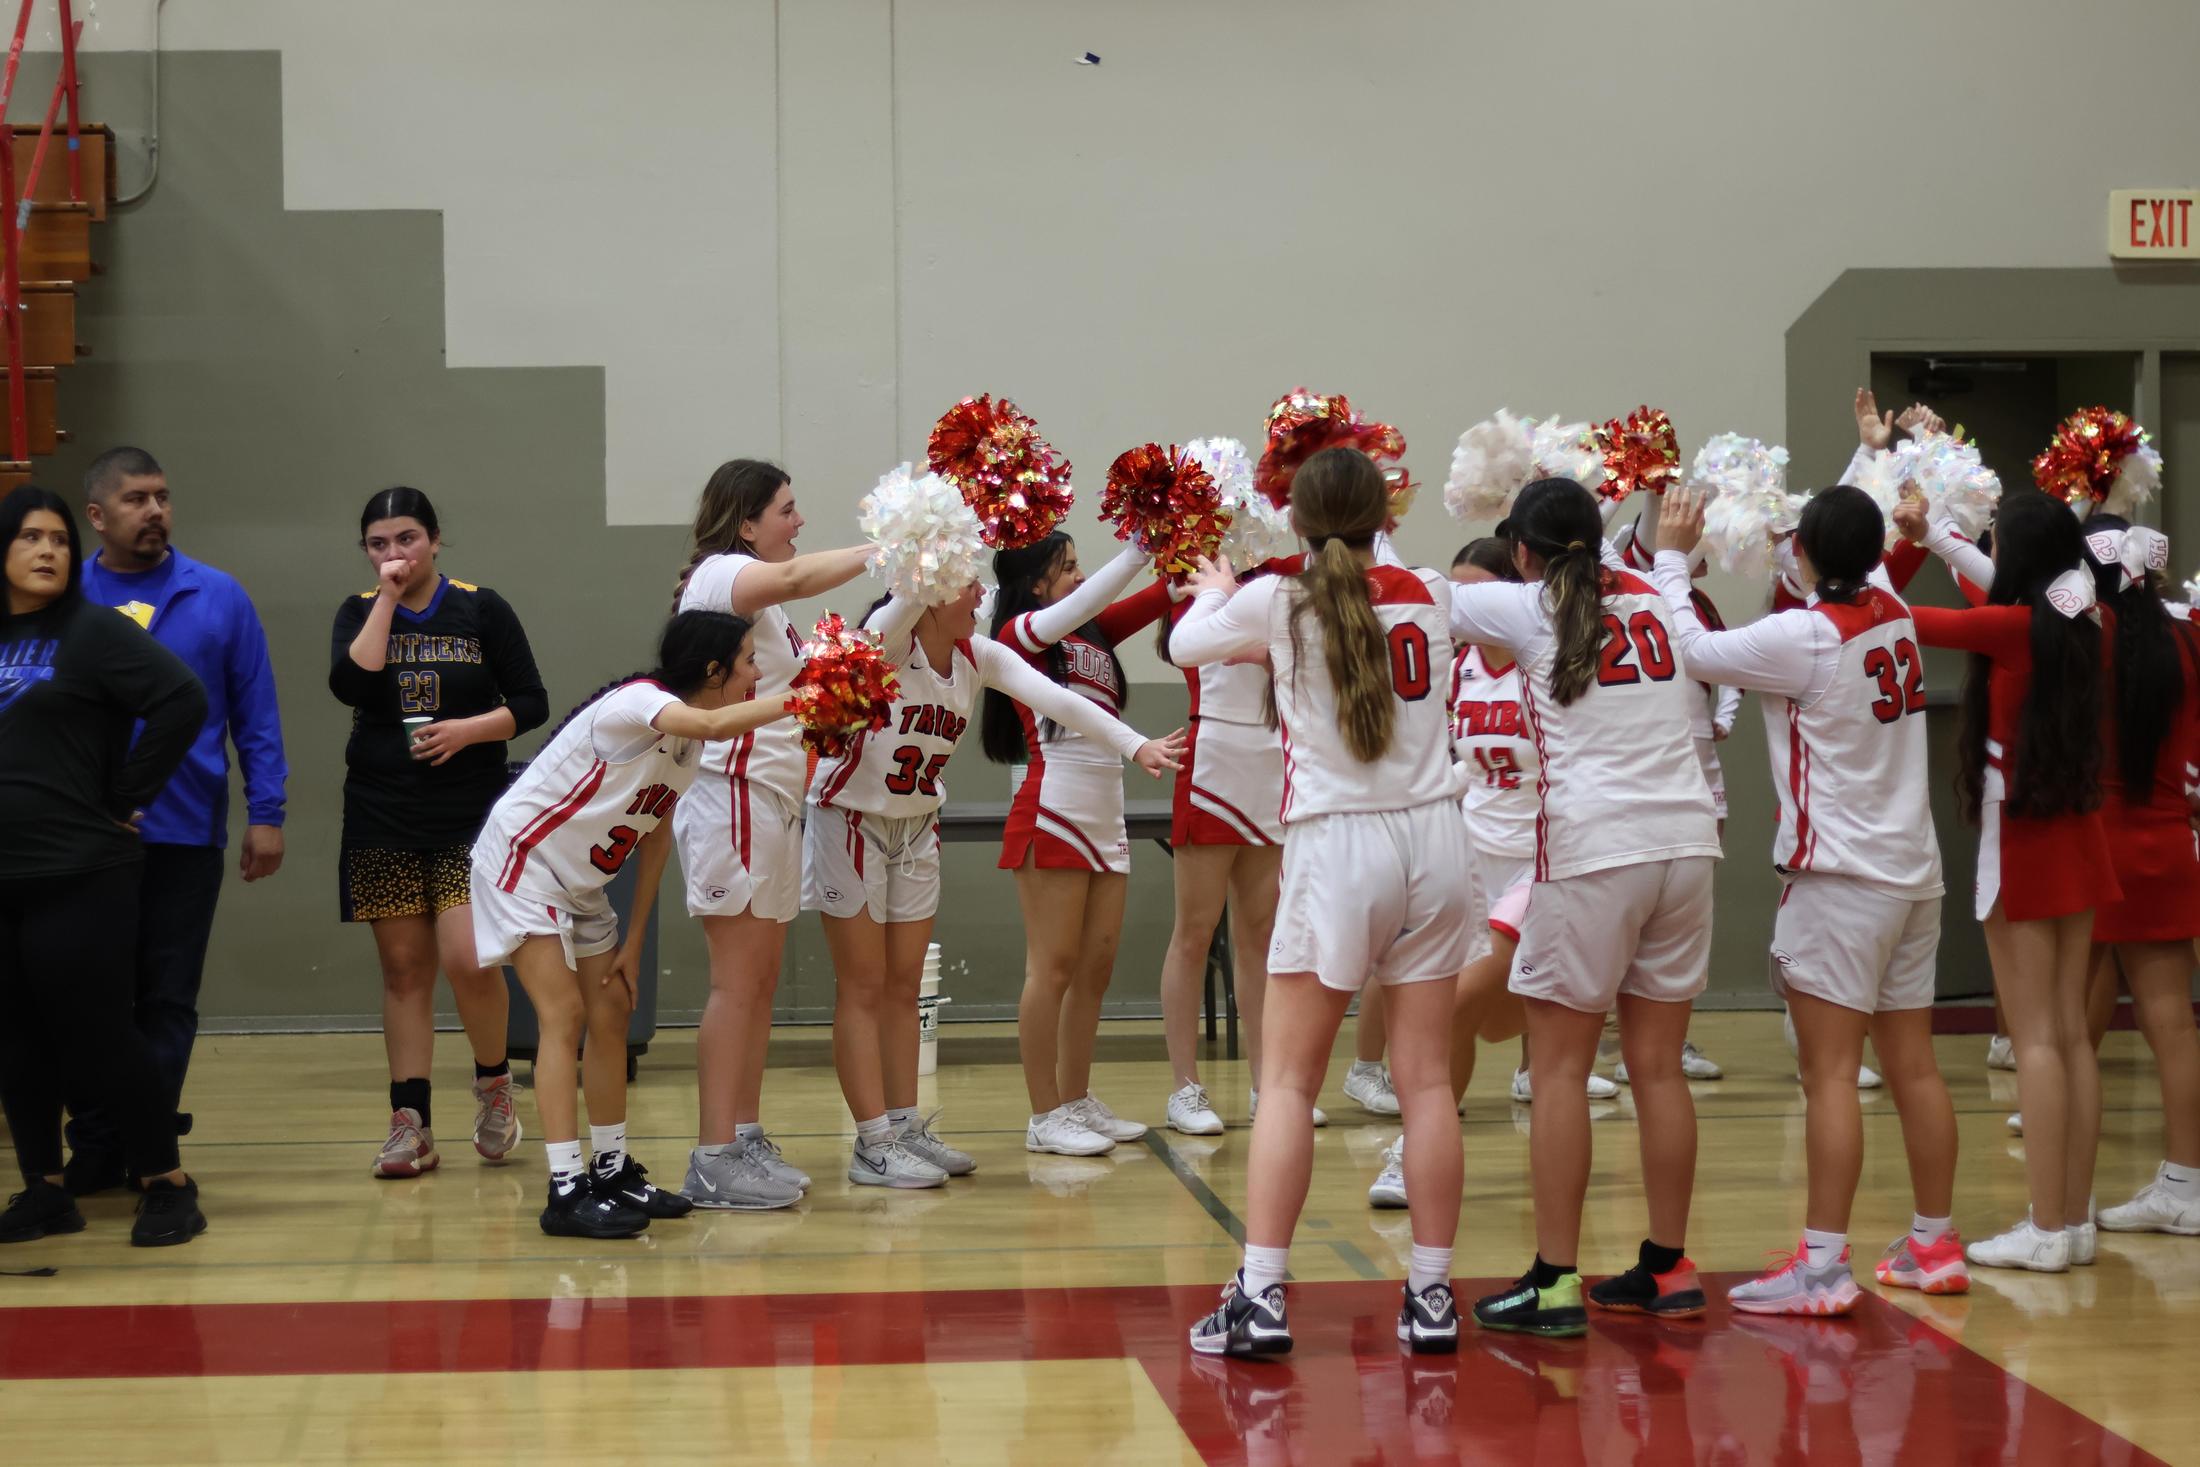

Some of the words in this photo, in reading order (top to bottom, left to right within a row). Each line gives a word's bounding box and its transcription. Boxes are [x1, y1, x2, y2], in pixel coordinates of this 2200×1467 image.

[2131, 199, 2193, 248] EXIT
[386, 633, 482, 664] NTHERS
[1597, 610, 1676, 687] 20
[398, 670, 440, 712] 23
[1863, 637, 1926, 724] 32
[885, 745, 950, 796] 35
[1474, 747, 1522, 790] 12
